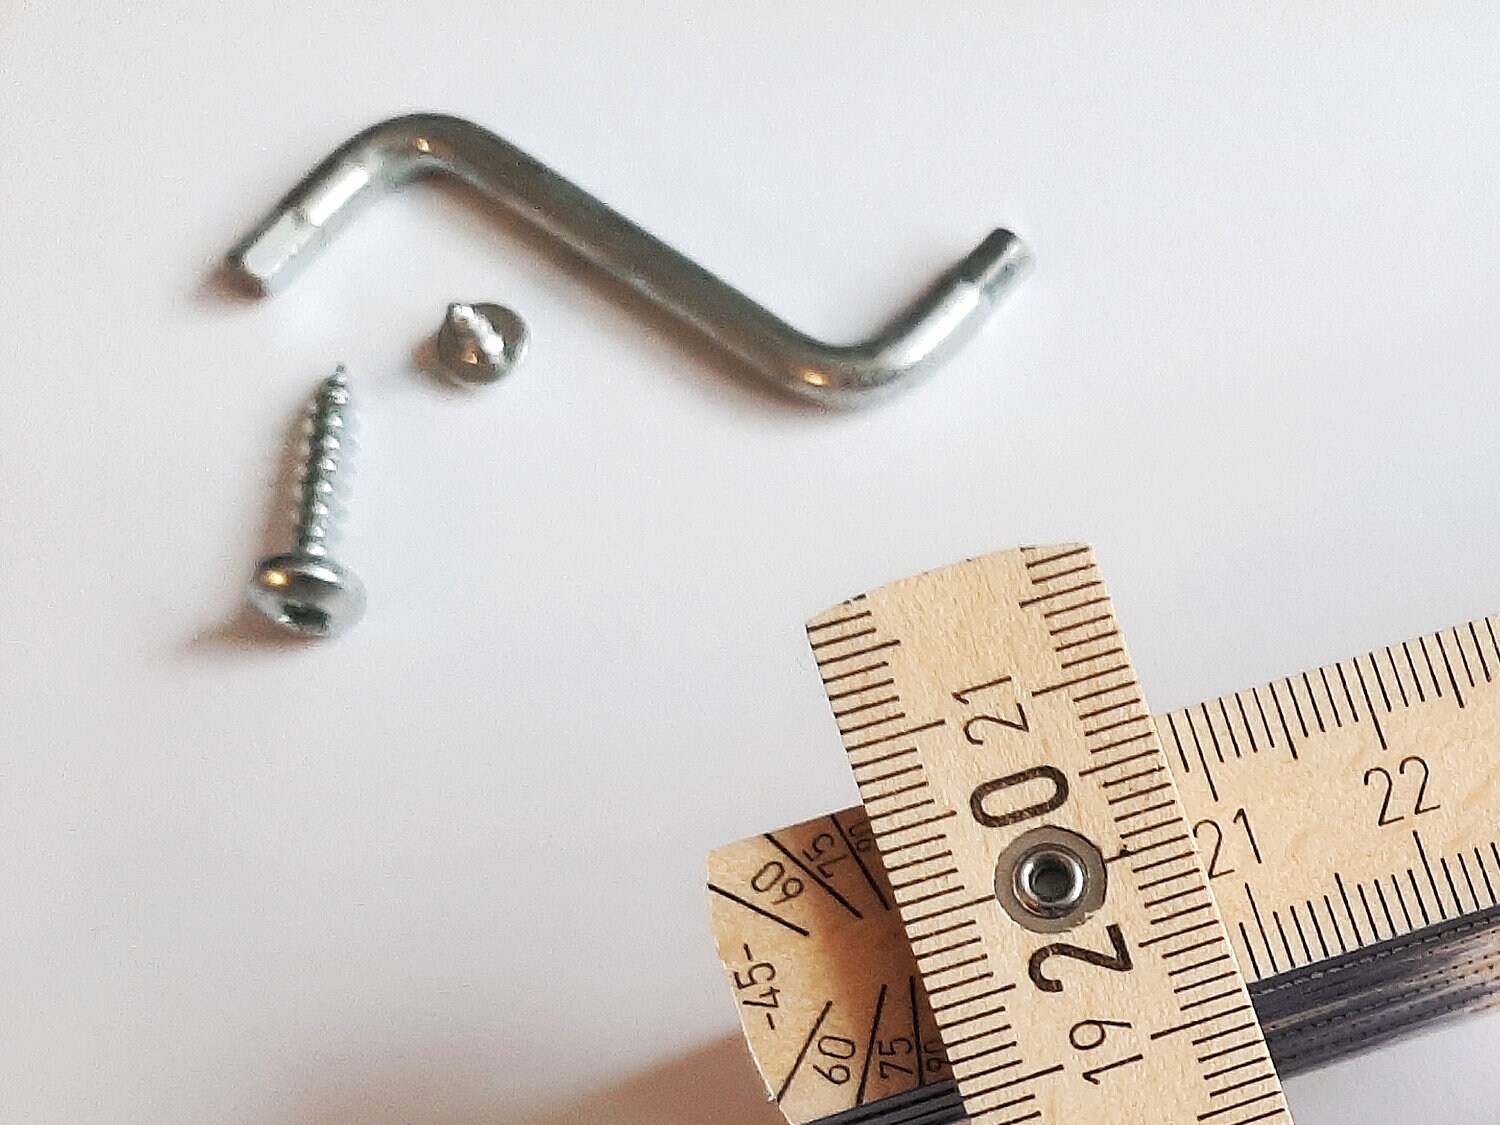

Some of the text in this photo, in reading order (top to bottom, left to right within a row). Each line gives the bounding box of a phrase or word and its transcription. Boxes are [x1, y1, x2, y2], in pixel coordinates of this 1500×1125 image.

[952, 676, 1029, 746] 21
[1363, 756, 1441, 827] 22
[802, 833, 847, 878] 75
[1192, 807, 1262, 880] 21
[751, 861, 805, 905] 60
[970, 765, 1134, 993] 20
[813, 1035, 856, 1085] 60
[879, 1038, 913, 1080] 75
[1069, 1019, 1143, 1085] 19
